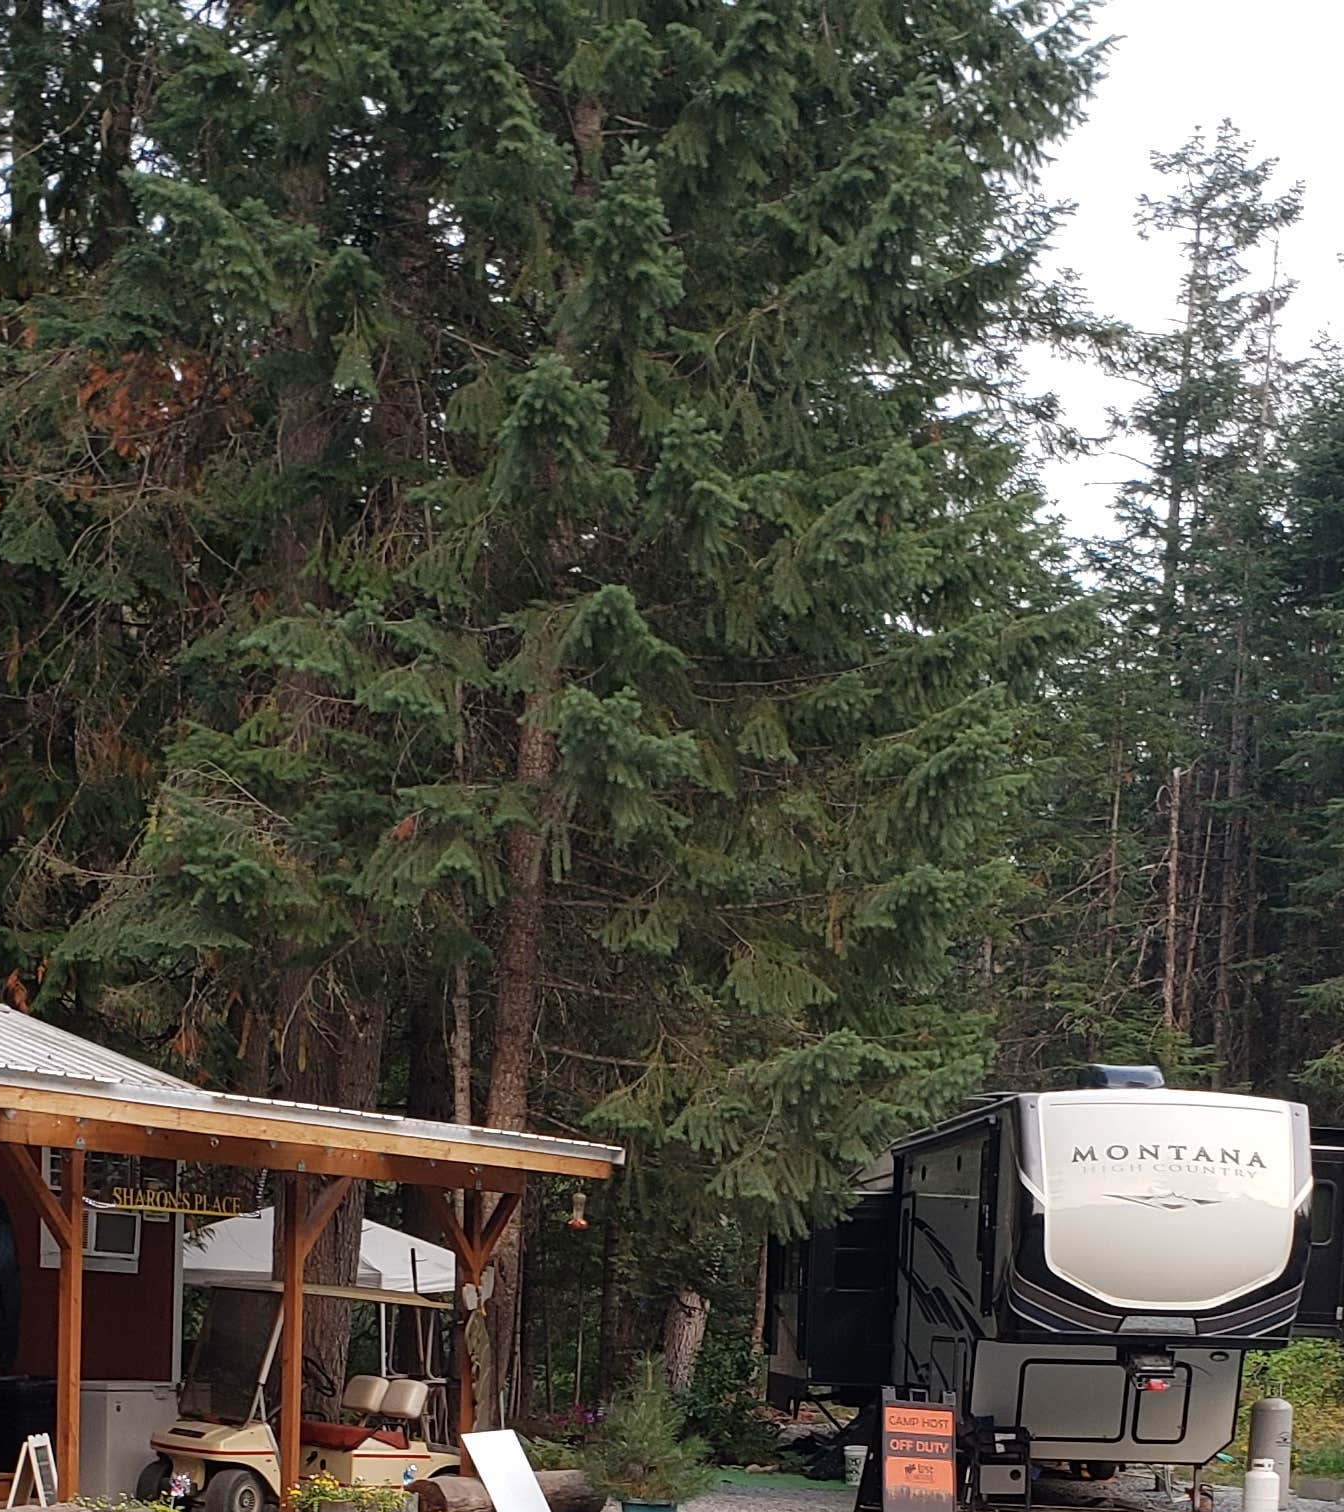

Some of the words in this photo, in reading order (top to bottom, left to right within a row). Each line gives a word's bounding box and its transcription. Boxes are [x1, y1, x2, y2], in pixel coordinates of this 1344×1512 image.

[1072, 1145, 1267, 1168] MONTANA
[1082, 1163, 1142, 1175] HIGH
[1153, 1163, 1257, 1179] COUNTRY
[112, 1187, 190, 1211] SHARON'S
[195, 1193, 241, 1214] PLACE
[889, 1415, 919, 1426] CAMP
[922, 1418, 949, 1429] HOST
[890, 1438, 913, 1451] OFF
[916, 1440, 949, 1454] DUTY
